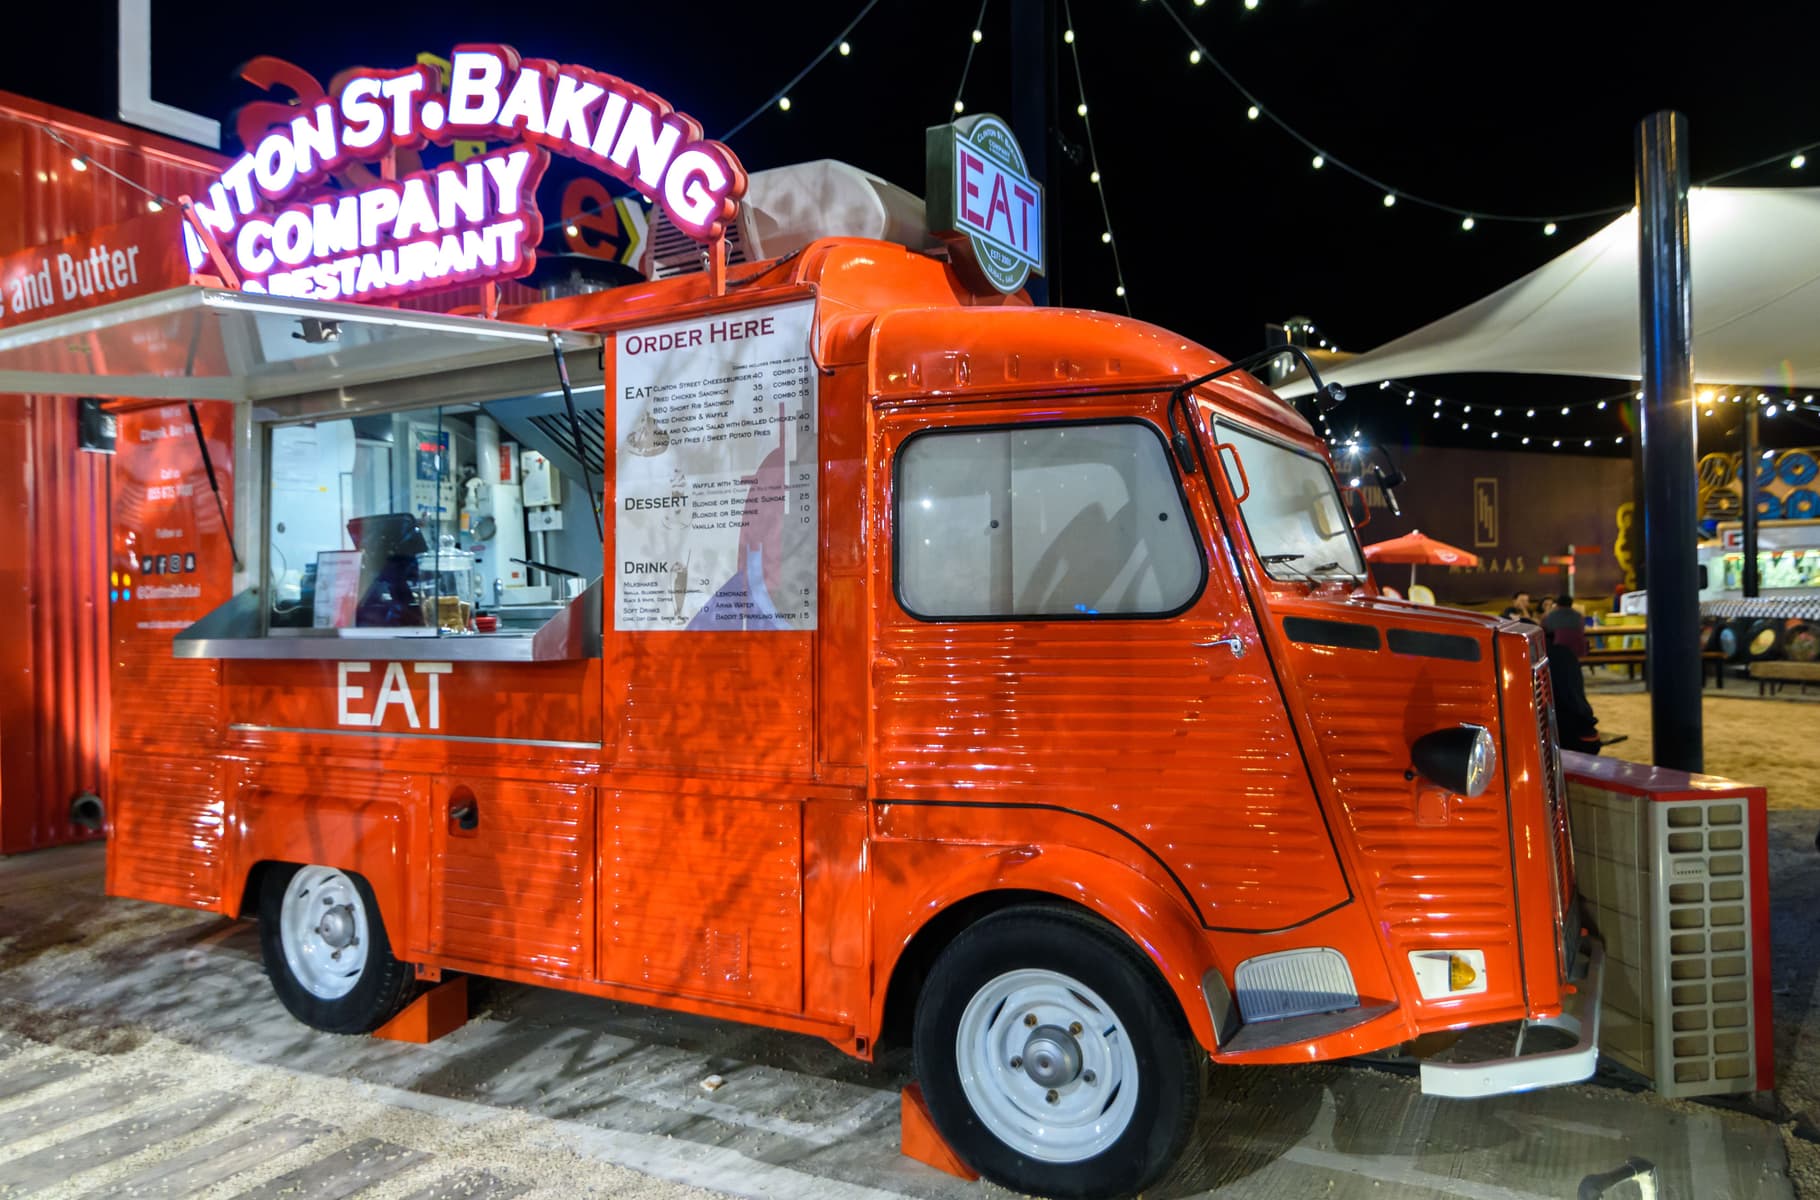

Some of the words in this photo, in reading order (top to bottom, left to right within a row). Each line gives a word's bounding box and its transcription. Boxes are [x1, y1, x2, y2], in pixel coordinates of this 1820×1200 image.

[448, 51, 728, 227] BAKING
[960, 149, 1035, 253] EAT
[236, 151, 533, 274] COMPANY
[268, 219, 524, 300] RESTAURANT
[11, 257, 54, 314] and
[57, 244, 139, 301] Butter
[625, 329, 702, 356] ORDER
[709, 317, 775, 343] HERE
[653, 384, 678, 392] CLINTON
[678, 381, 701, 389] STREET
[702, 374, 752, 386] CHEESEBURGER
[752, 371, 764, 379] 40
[772, 368, 796, 377] COMBO
[798, 365, 809, 373] 55
[625, 386, 653, 400] EAT
[670, 393, 696, 401] CHICKEN
[698, 389, 729, 398] SANDWICH
[752, 383, 763, 391] 35
[772, 379, 796, 388] COMBO
[798, 377, 809, 385] 55
[653, 406, 669, 414] BBQ
[669, 404, 690, 412] SHORT
[703, 400, 735, 409] SANDWICH
[752, 394, 764, 402] 40
[772, 391, 797, 400] COMBO
[798, 389, 810, 397] 55
[670, 415, 696, 424] CHICKEN
[704, 411, 729, 419] WAFFLE
[752, 406, 764, 414] 35
[682, 425, 704, 434] QUINOA
[705, 422, 726, 431] SALAD
[726, 420, 741, 428] WITH
[741, 418, 768, 427] GRILLED
[768, 415, 797, 424] CHICKEN
[670, 436, 682, 445] CUT
[683, 435, 701, 443] FRIES
[706, 432, 728, 442] SWEET
[729, 431, 752, 439] POTATO
[753, 429, 771, 437] FRIES
[692, 481, 716, 489] WAFFLE
[717, 479, 732, 487] WITH
[799, 473, 810, 481] 30
[624, 495, 689, 511] DESSERT
[692, 500, 718, 508] BLONDIE
[730, 497, 759, 505] BROWNIE
[760, 494, 786, 503] SUNDAE
[799, 492, 810, 500] 25
[692, 511, 718, 519] BLONDIE
[730, 508, 759, 516] BROWNIE
[800, 504, 810, 512] 10
[692, 522, 715, 530] VANILLA
[716, 521, 727, 529] ICE
[728, 519, 750, 528] CREAM
[800, 516, 810, 524] 10
[624, 561, 668, 574] DRINK
[699, 578, 710, 586] 30
[733, 601, 754, 609] WATER
[337, 662, 453, 730] EAT
